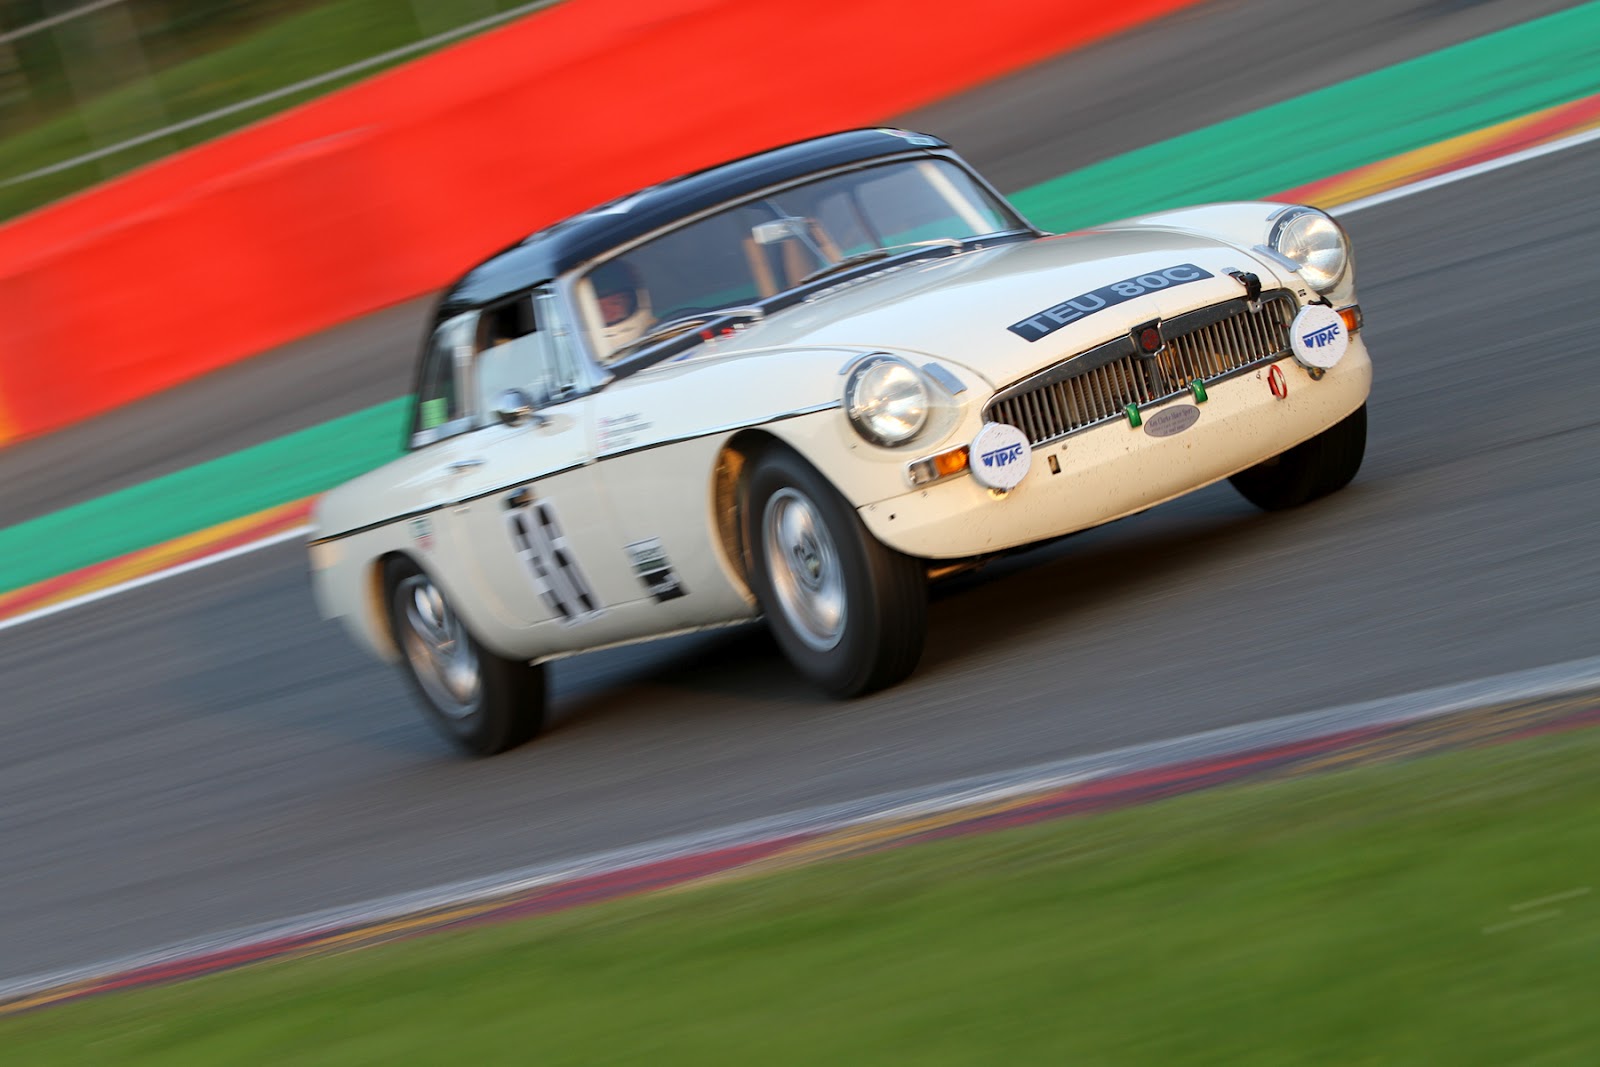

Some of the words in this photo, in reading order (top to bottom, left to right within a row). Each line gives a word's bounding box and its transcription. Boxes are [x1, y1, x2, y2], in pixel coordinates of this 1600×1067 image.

[1016, 293, 1106, 334] TEU
[1110, 267, 1200, 297] 80C
[1303, 326, 1340, 348] WIPAC
[982, 446, 1023, 467] WIPAC
